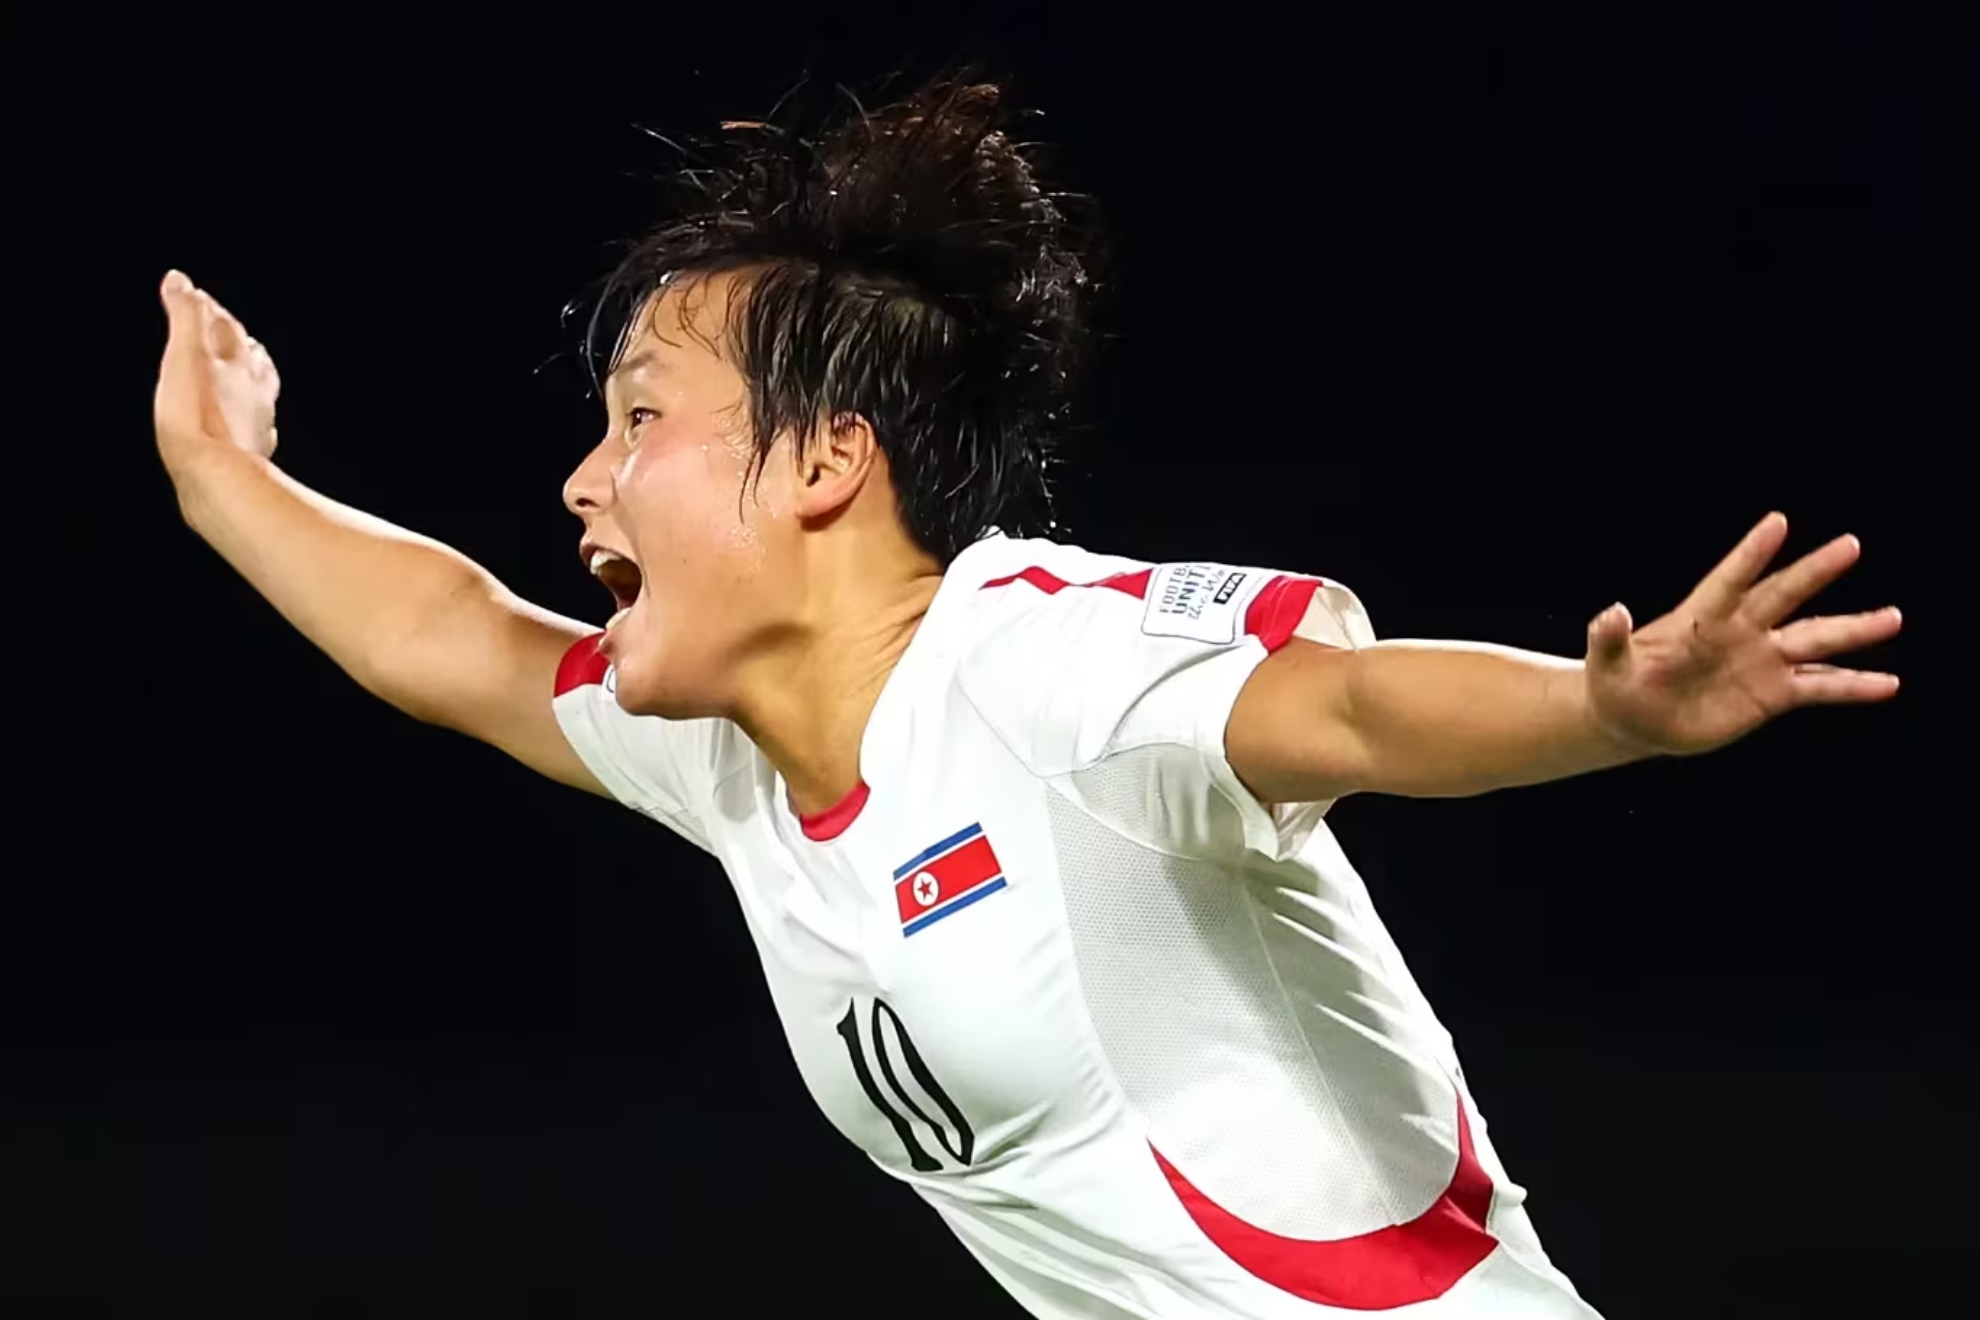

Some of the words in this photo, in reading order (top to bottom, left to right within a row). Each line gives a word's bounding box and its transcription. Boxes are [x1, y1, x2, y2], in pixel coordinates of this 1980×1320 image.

[1159, 565, 1190, 613] FOOTB
[1201, 569, 1225, 591] Wo
[836, 997, 975, 1172] 10
